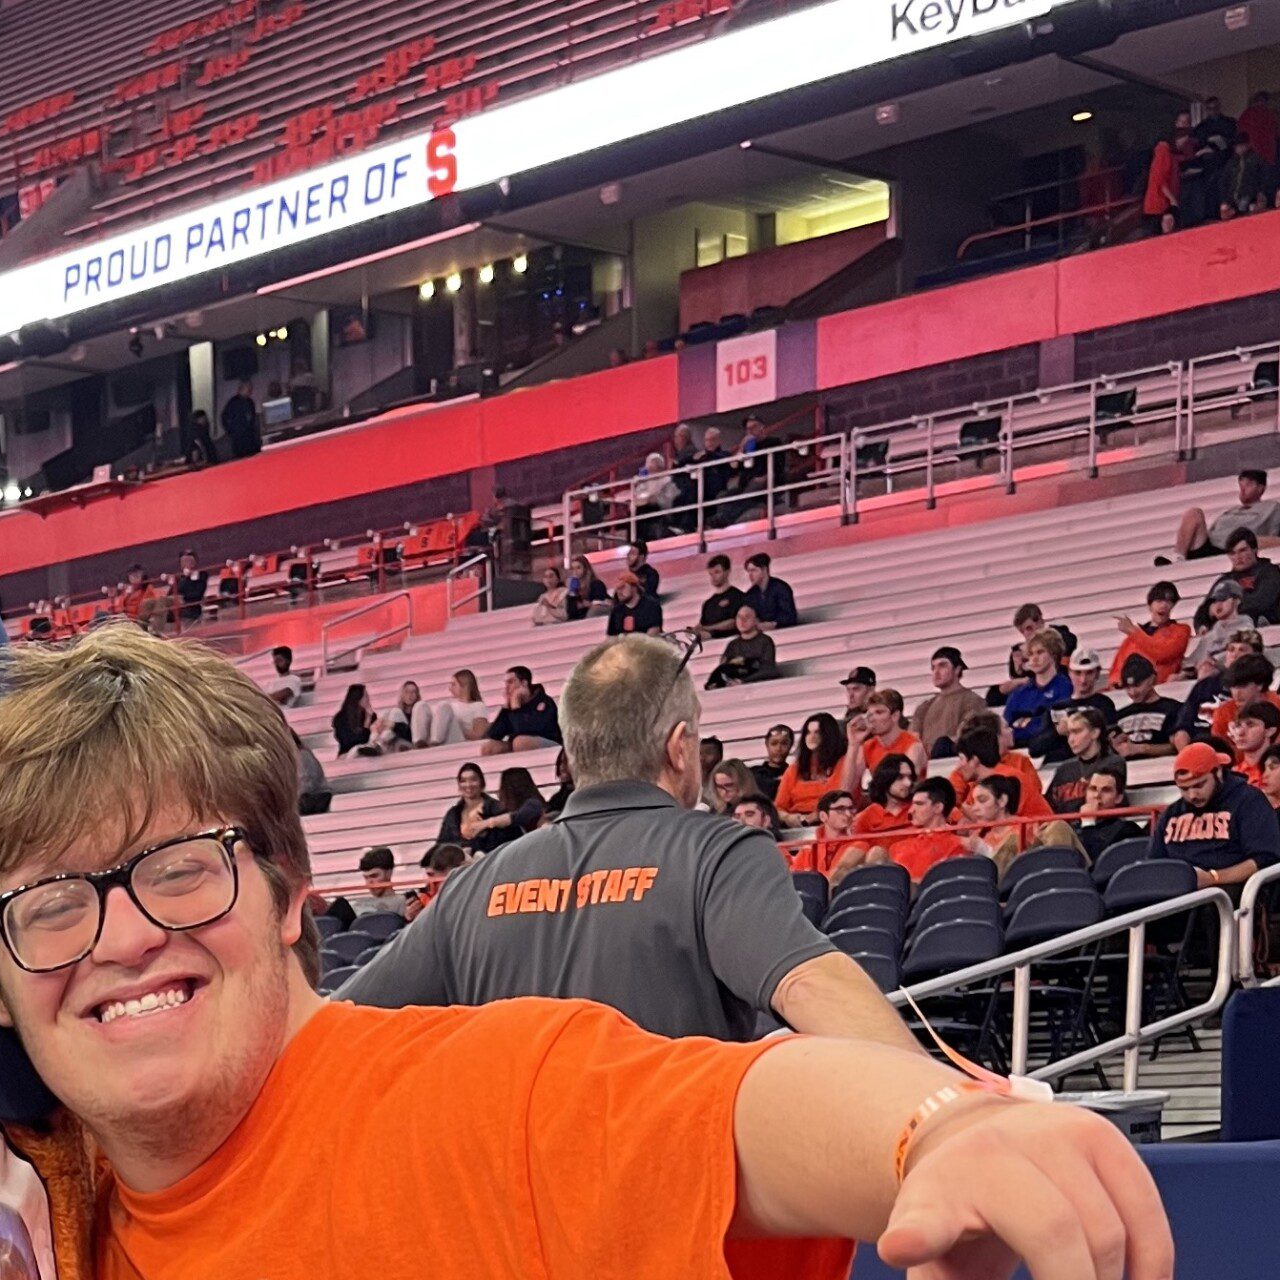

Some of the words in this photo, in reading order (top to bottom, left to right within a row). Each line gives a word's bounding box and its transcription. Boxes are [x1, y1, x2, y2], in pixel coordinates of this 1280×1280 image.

[64, 234, 172, 302] PROUD
[185, 175, 349, 263] PARTNER
[364, 153, 412, 207] OF
[426, 127, 458, 198] S
[724, 355, 767, 387] 103
[487, 878, 573, 917] EVENT
[576, 867, 659, 909] STAFF
